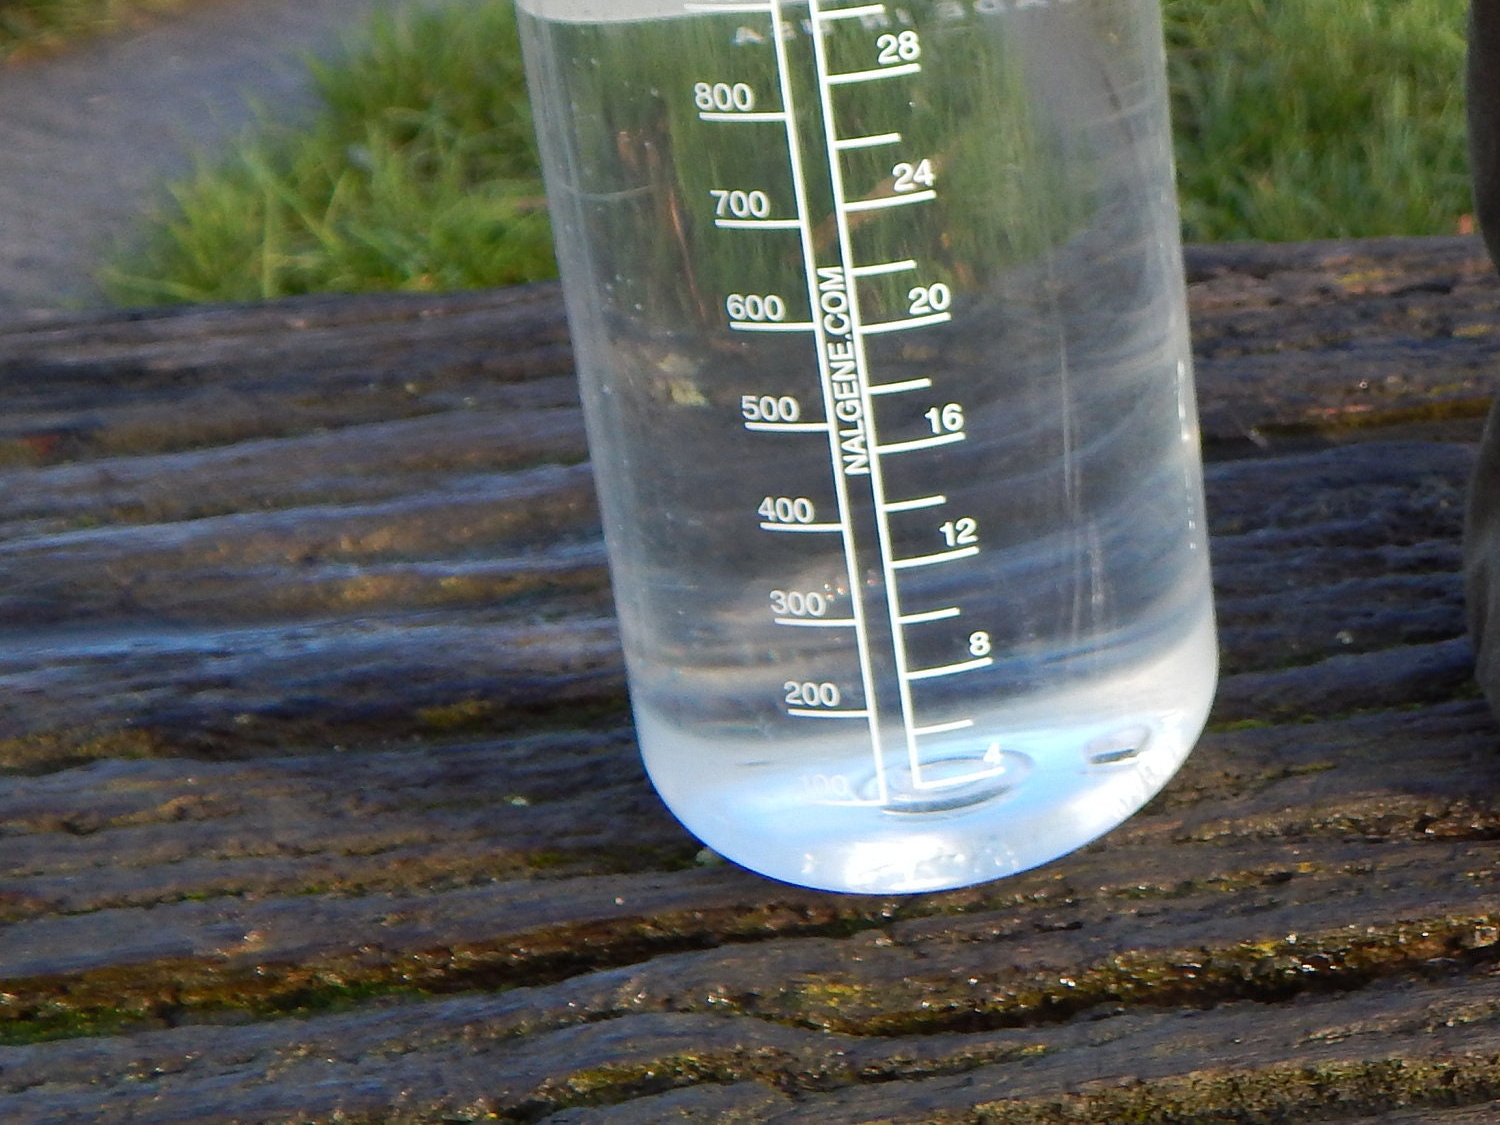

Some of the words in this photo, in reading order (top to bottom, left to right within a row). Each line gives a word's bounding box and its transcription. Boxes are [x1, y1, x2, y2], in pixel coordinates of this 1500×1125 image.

[876, 29, 921, 64] 28
[694, 81, 755, 113] 800
[891, 158, 936, 192] 24
[710, 189, 771, 221] 700
[726, 292, 786, 323] 600
[908, 282, 951, 314] 20
[817, 266, 871, 475] NALGENE.COM
[740, 395, 800, 423] 500
[924, 402, 965, 434] 16
[757, 497, 815, 525] 400
[939, 517, 979, 548] 12
[769, 590, 826, 618] 300
[968, 631, 991, 657] 8
[783, 681, 841, 709] 200
